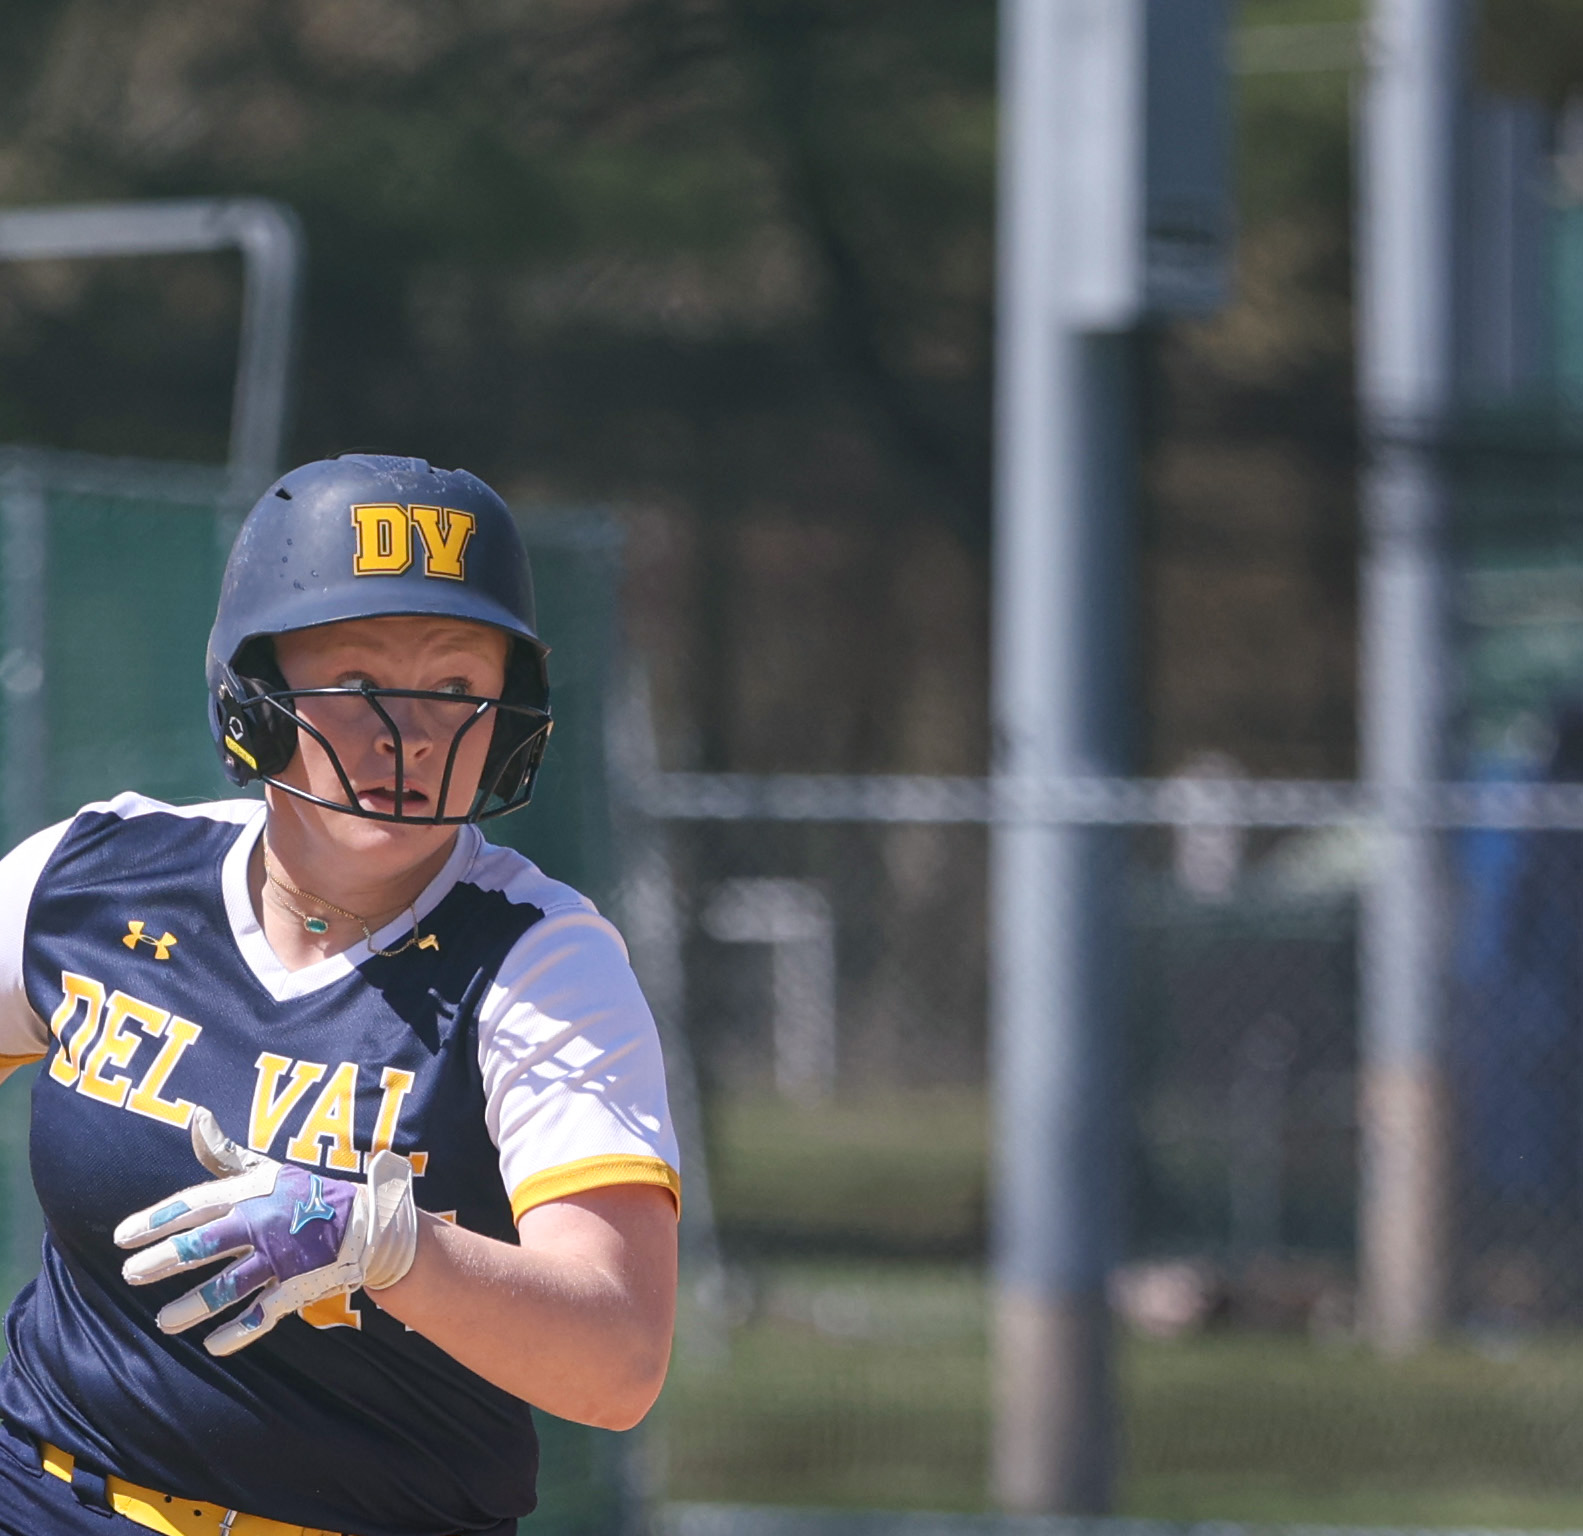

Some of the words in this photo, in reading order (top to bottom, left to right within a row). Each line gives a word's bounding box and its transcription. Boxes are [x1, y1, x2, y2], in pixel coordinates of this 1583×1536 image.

[351, 503, 476, 580] DV
[49, 970, 203, 1130] DEL
[248, 1052, 429, 1177] VAL
